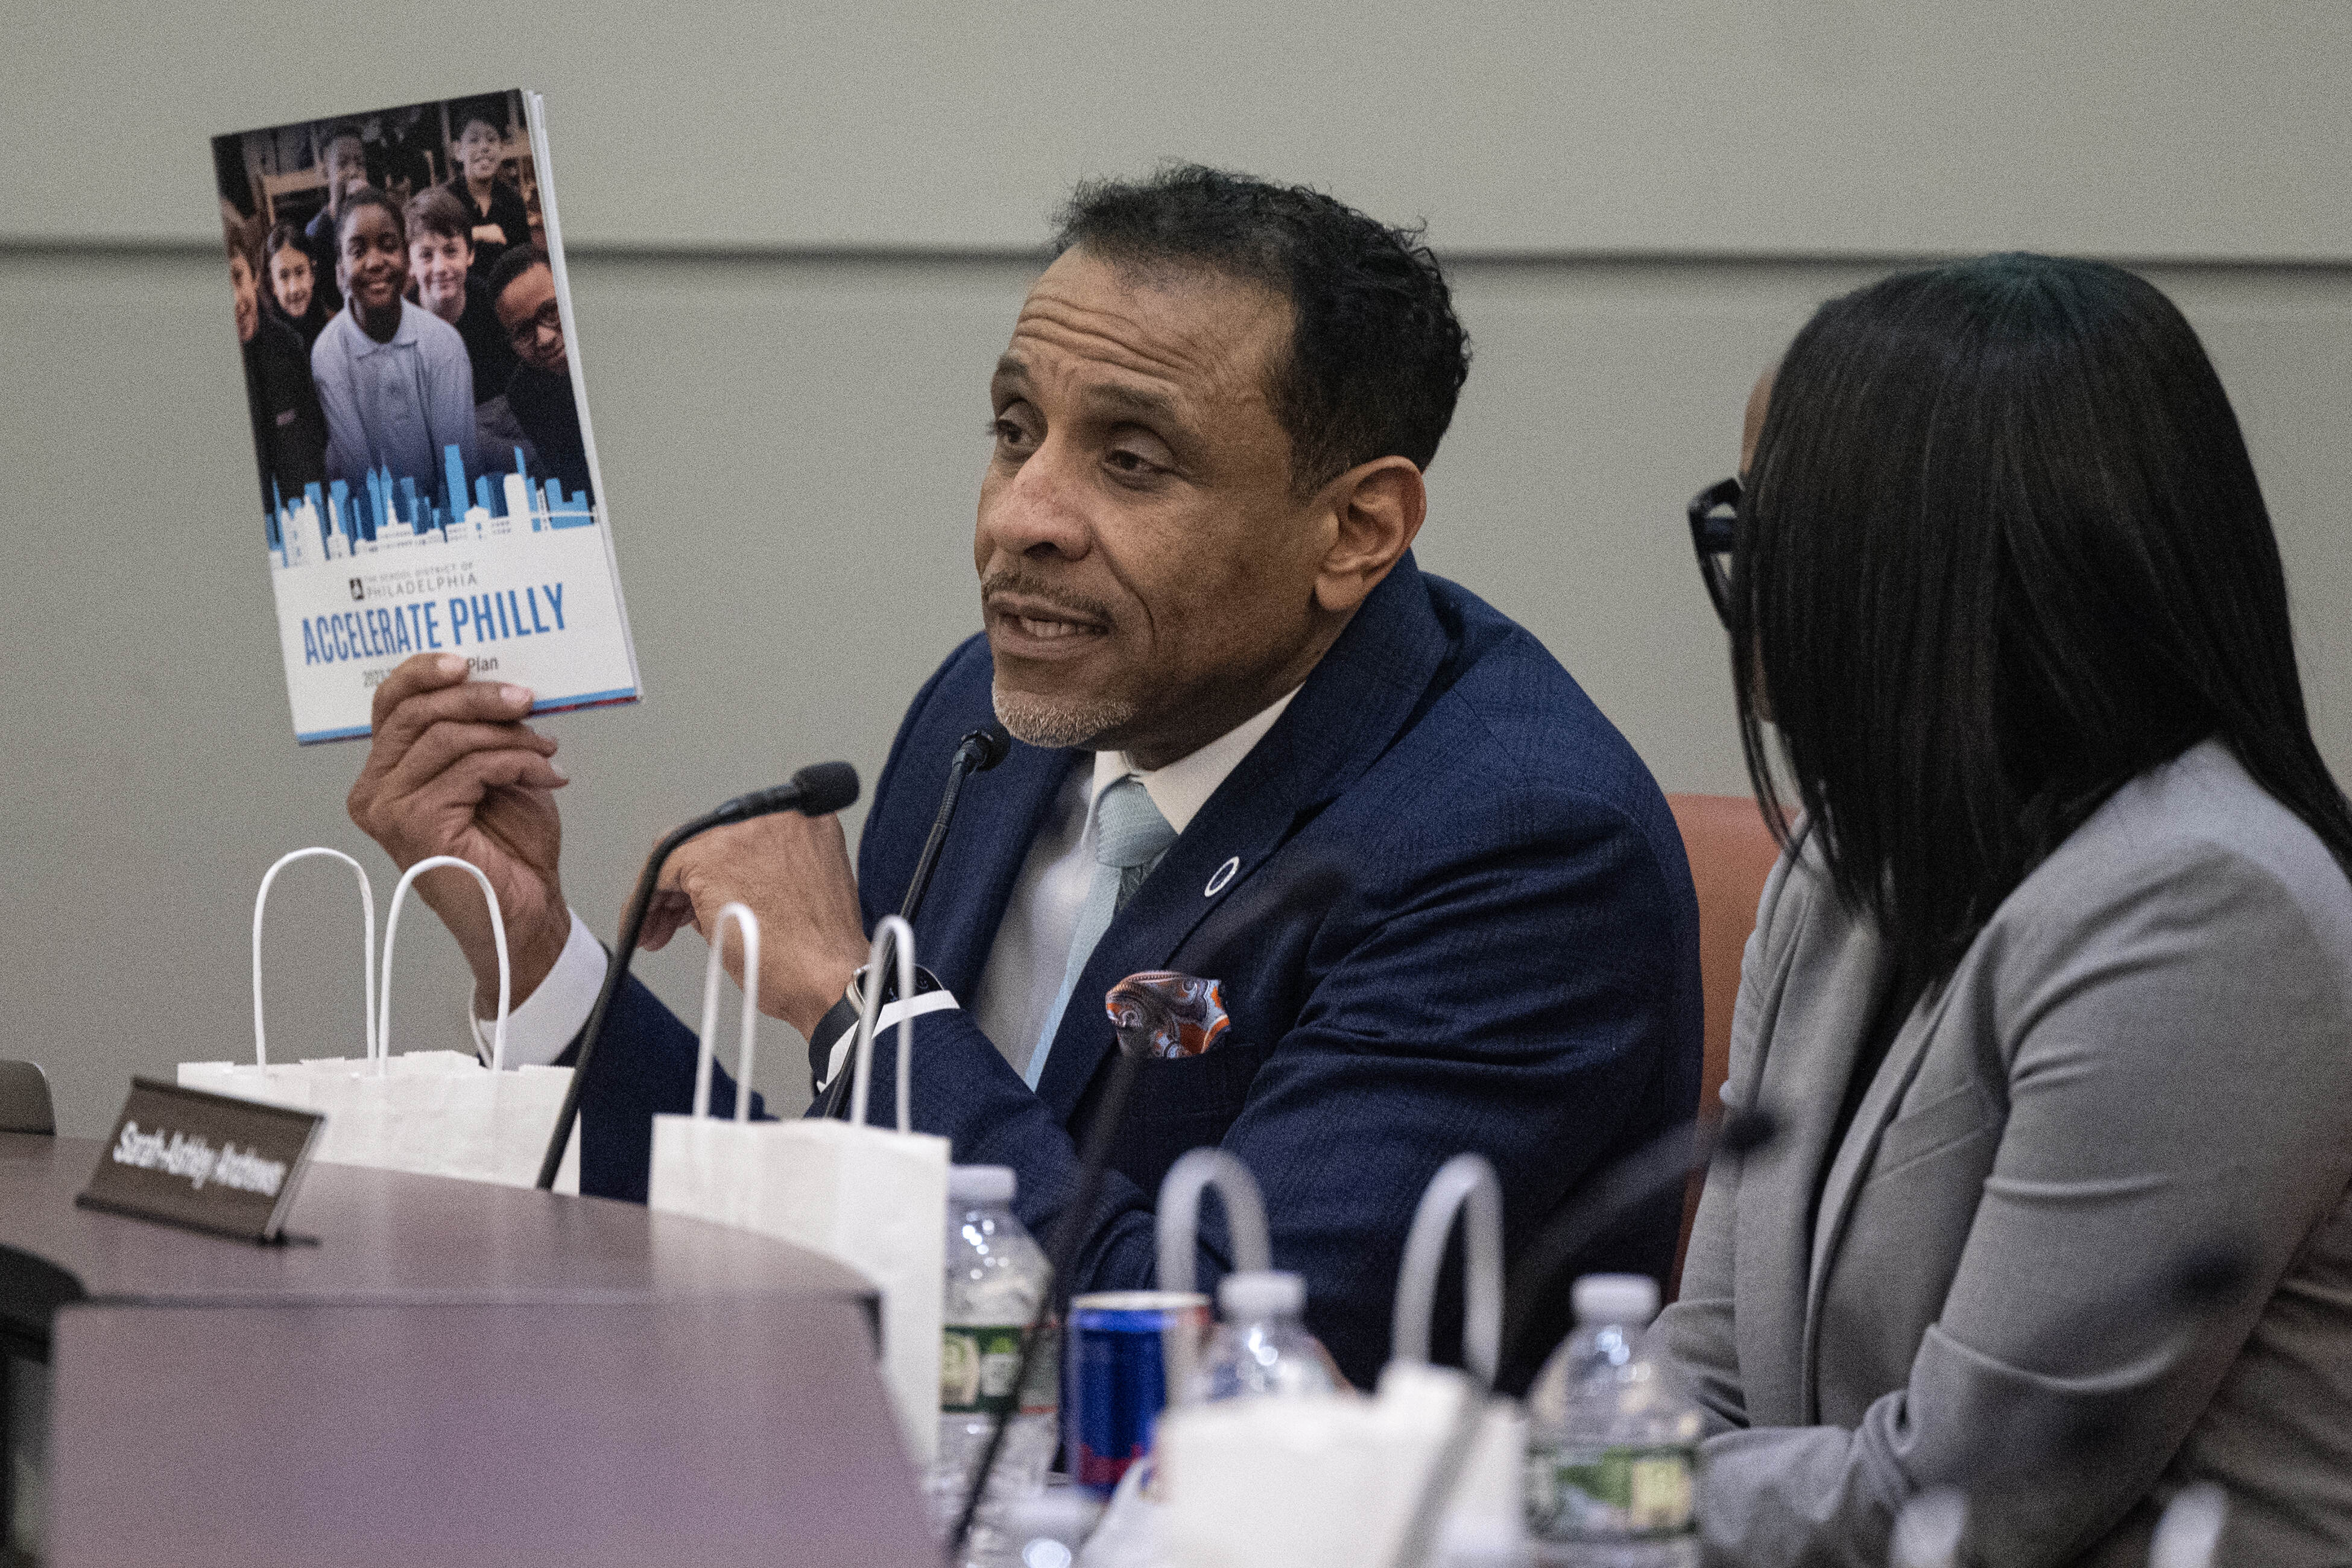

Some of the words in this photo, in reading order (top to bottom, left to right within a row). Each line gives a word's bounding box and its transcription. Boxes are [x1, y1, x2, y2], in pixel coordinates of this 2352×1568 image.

[365, 572, 477, 599] PHILADELPHIA
[302, 601, 442, 664] ACCELERATE
[449, 583, 566, 646] PHILLY
[467, 656, 499, 675] Plan
